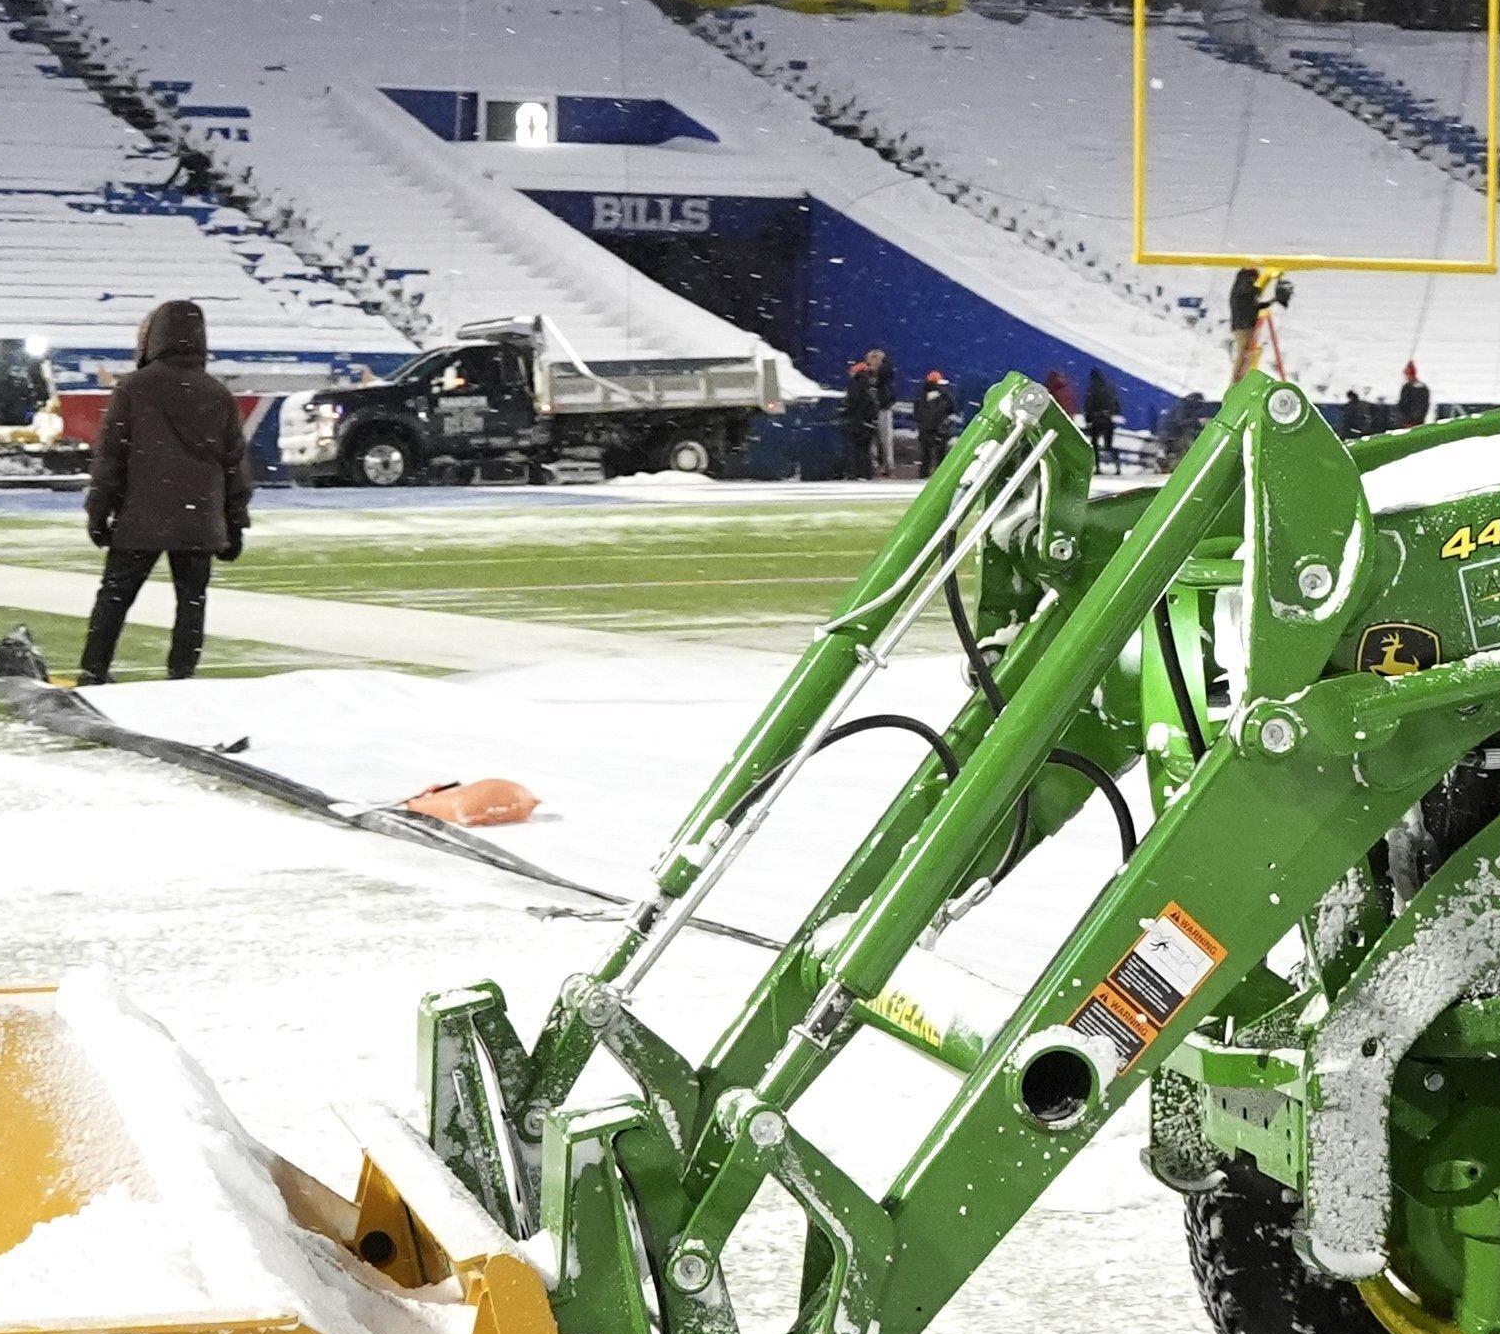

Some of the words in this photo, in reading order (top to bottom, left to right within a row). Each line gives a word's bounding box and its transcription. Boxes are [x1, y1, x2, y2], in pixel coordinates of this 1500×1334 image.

[592, 193, 711, 235] BILLS
[1179, 917, 1219, 956] WARNING
[1109, 999, 1150, 1039] WARNING
